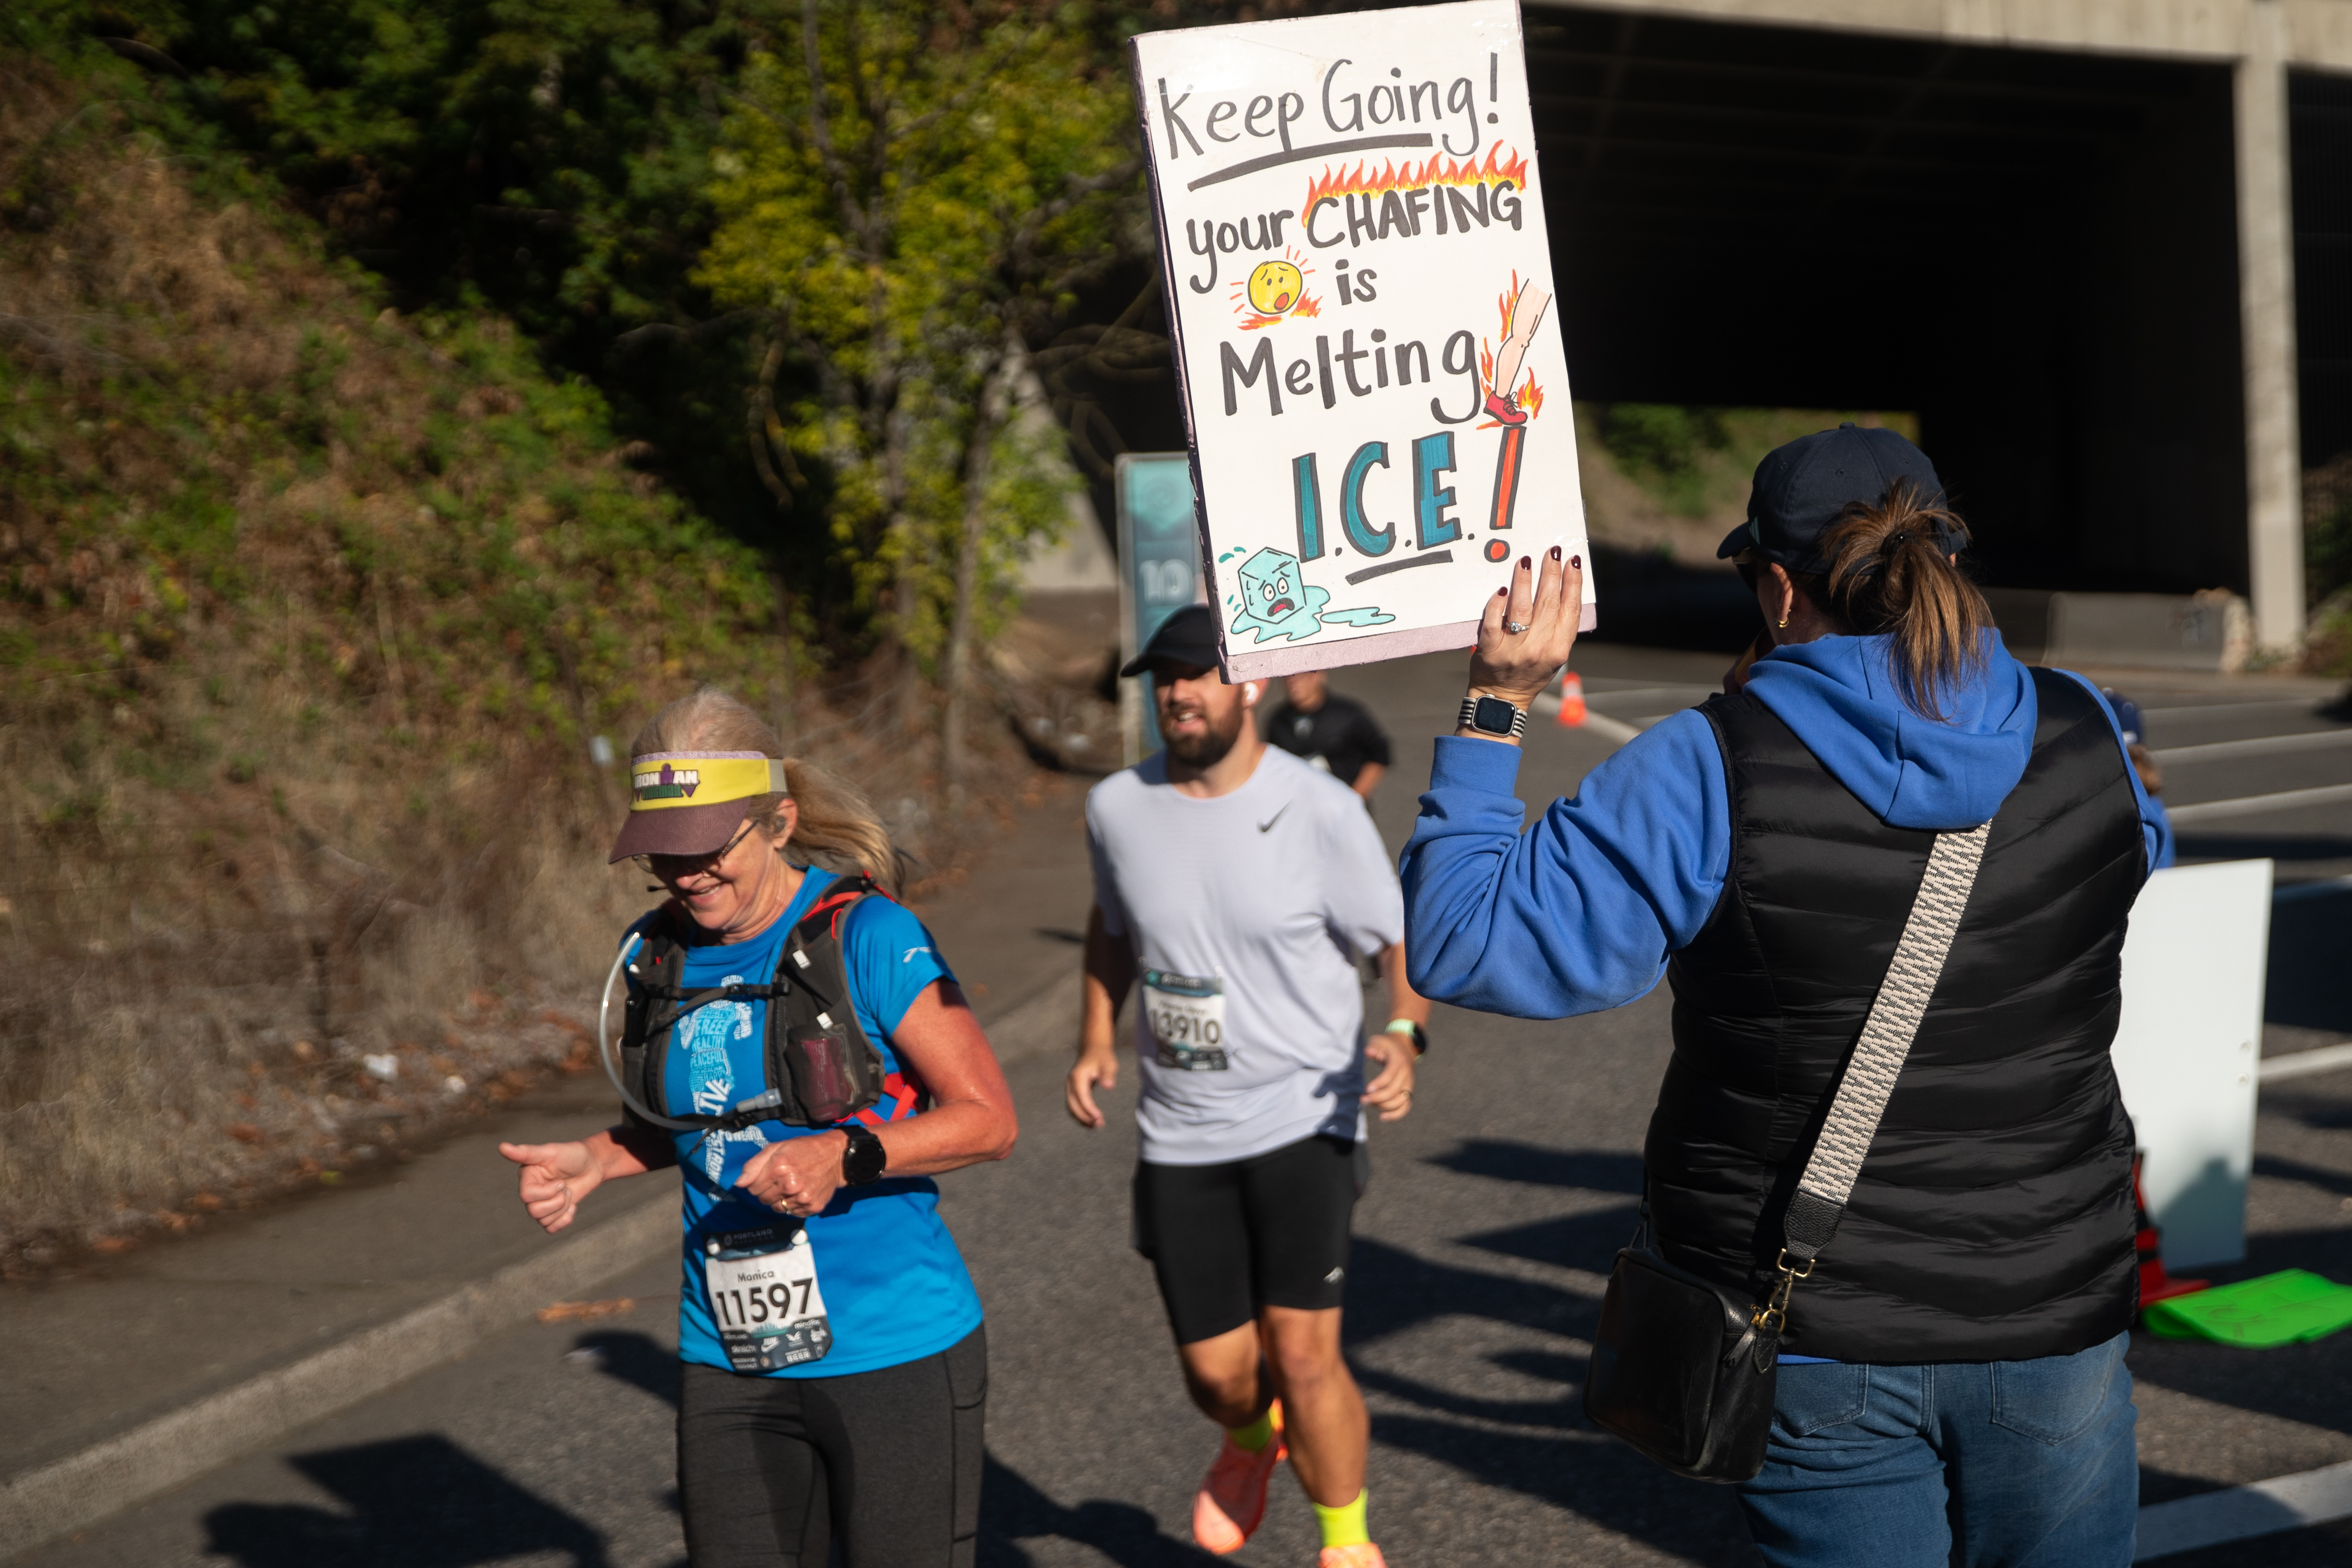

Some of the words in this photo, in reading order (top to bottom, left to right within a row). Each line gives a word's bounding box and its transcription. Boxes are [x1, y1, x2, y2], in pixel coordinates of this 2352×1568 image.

[1157, 78, 1304, 160] Keep
[1322, 52, 1500, 156] Going!
[1186, 208, 1294, 293] your
[1306, 181, 1522, 248] CHAFING
[1336, 259, 1377, 305] is
[1220, 328, 1481, 424] Melting
[692, 1035, 726, 1052] HEALTHY
[737, 1270, 775, 1283] Monica
[715, 1277, 813, 1326] 11597
[786, 1351, 811, 1363] BEER
